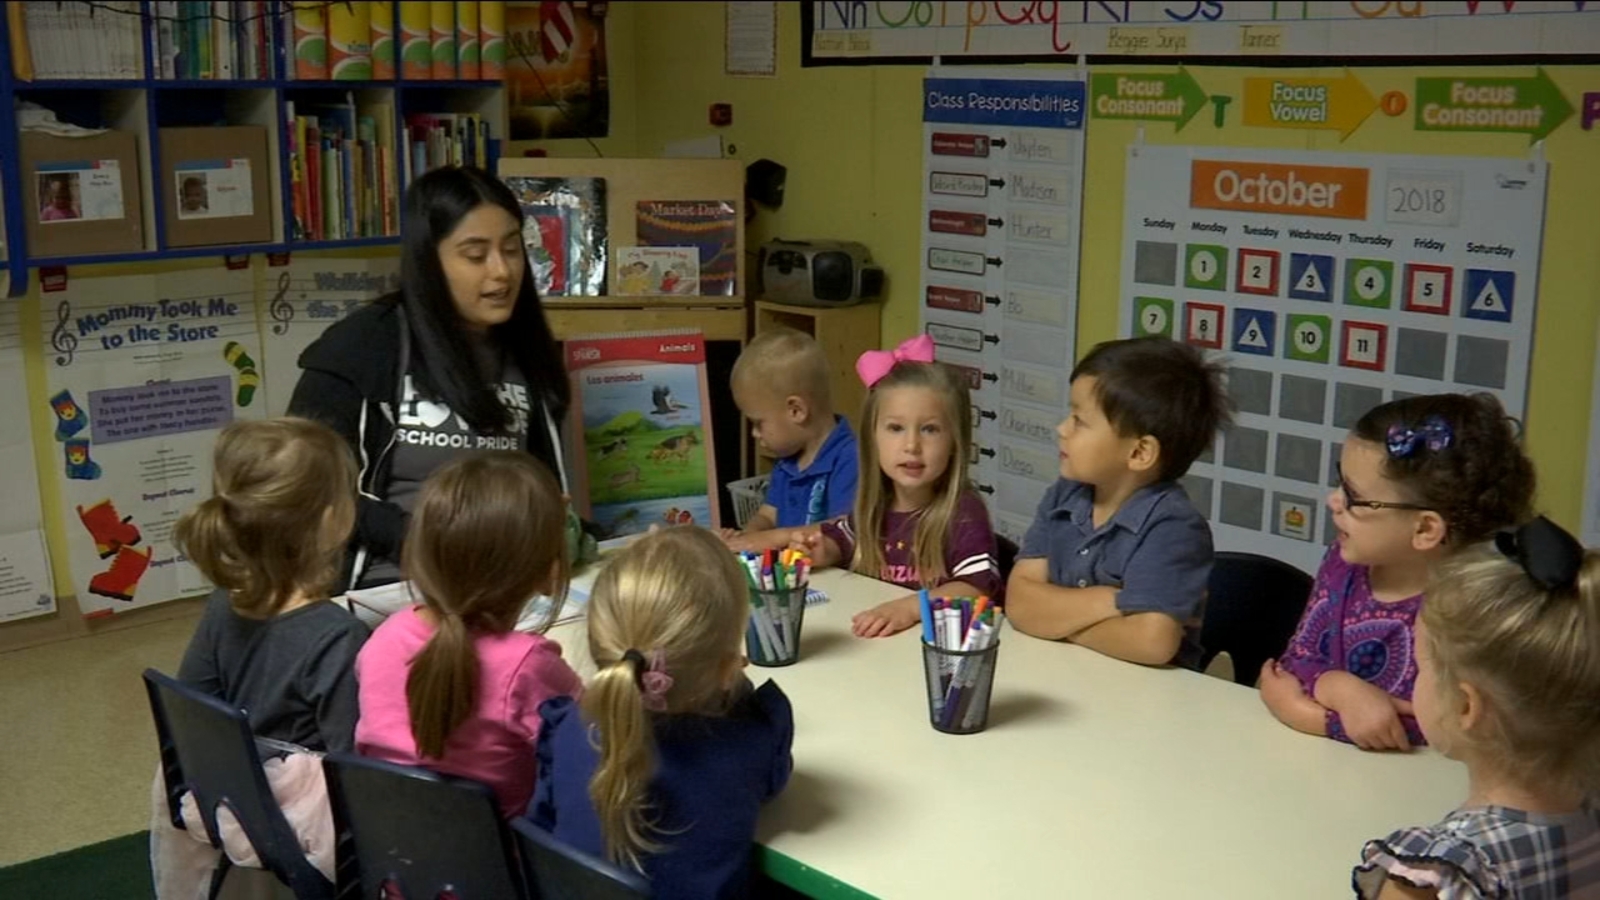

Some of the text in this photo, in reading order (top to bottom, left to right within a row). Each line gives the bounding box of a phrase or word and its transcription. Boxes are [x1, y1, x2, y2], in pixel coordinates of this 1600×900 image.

[1116, 79, 1164, 97] Focus
[1272, 82, 1326, 102] Focus
[1450, 83, 1516, 105] Focus
[927, 91, 1080, 115] Class Responsibilities
[1096, 96, 1186, 117] Consonant
[1211, 95, 1233, 128] T
[1270, 101, 1328, 122] Vowel
[1422, 103, 1544, 128] Consonant
[1012, 174, 1058, 200] Madison
[1214, 169, 1344, 210] October
[1392, 186, 1447, 214] 2018
[650, 202, 695, 216] Market
[1012, 211, 1052, 239] Hunter
[1143, 217, 1176, 232] Sunday
[1191, 220, 1228, 236] Monday
[1242, 224, 1280, 240] Tuesday
[1288, 228, 1343, 246] Wednesday
[1348, 232, 1394, 249] Thursday
[1413, 237, 1447, 253] Friday
[1466, 241, 1516, 259] Saturday
[1200, 259, 1208, 274] 1
[1252, 265, 1262, 280] 2
[1305, 274, 1316, 289] 3
[1363, 275, 1375, 291] 4
[1423, 282, 1433, 297] 5
[1483, 292, 1494, 308] 6
[76, 297, 239, 337] Mommy Took Me
[1149, 313, 1158, 326] 7
[1199, 318, 1208, 334] 8
[101, 323, 219, 350] to the Store
[1248, 328, 1258, 342] 9
[1300, 329, 1317, 345] 10
[659, 343, 696, 354] Animals
[1356, 338, 1369, 352] 11
[603, 373, 644, 384] animales
[395, 427, 519, 451] SCHOOL PRIDE
